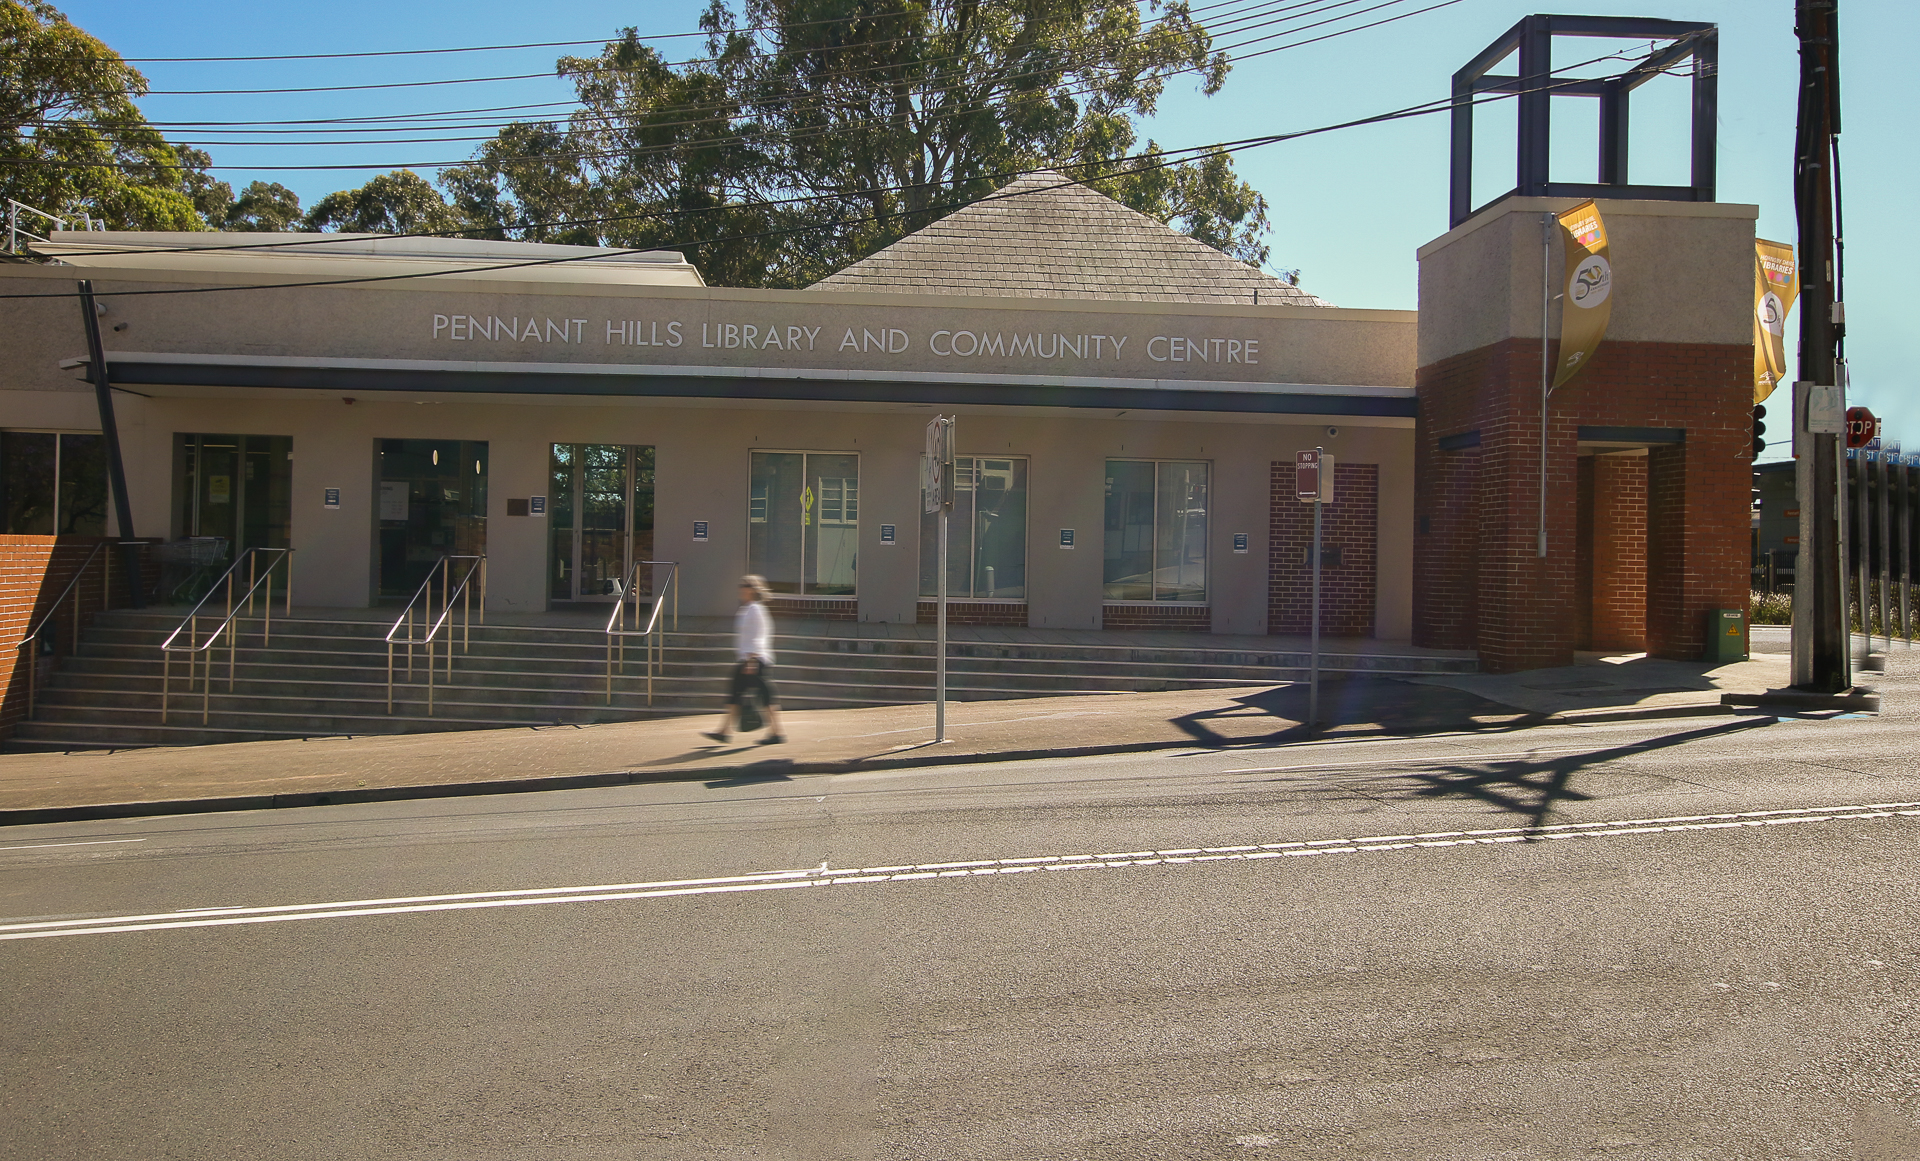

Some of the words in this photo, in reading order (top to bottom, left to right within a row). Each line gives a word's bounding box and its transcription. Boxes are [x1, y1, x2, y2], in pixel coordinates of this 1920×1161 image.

[1760, 260, 1794, 275] IBRARIES
[433, 314, 588, 344] PENNANT
[605, 320, 684, 348] HILLS
[702, 322, 822, 352] LIBRARY
[837, 328, 910, 355] AND
[929, 330, 1129, 360] COMMUNITY
[1146, 336, 1259, 365] CENTRE
[1303, 453, 1312, 461] NO
[1297, 462, 1318, 470] STOPPING
